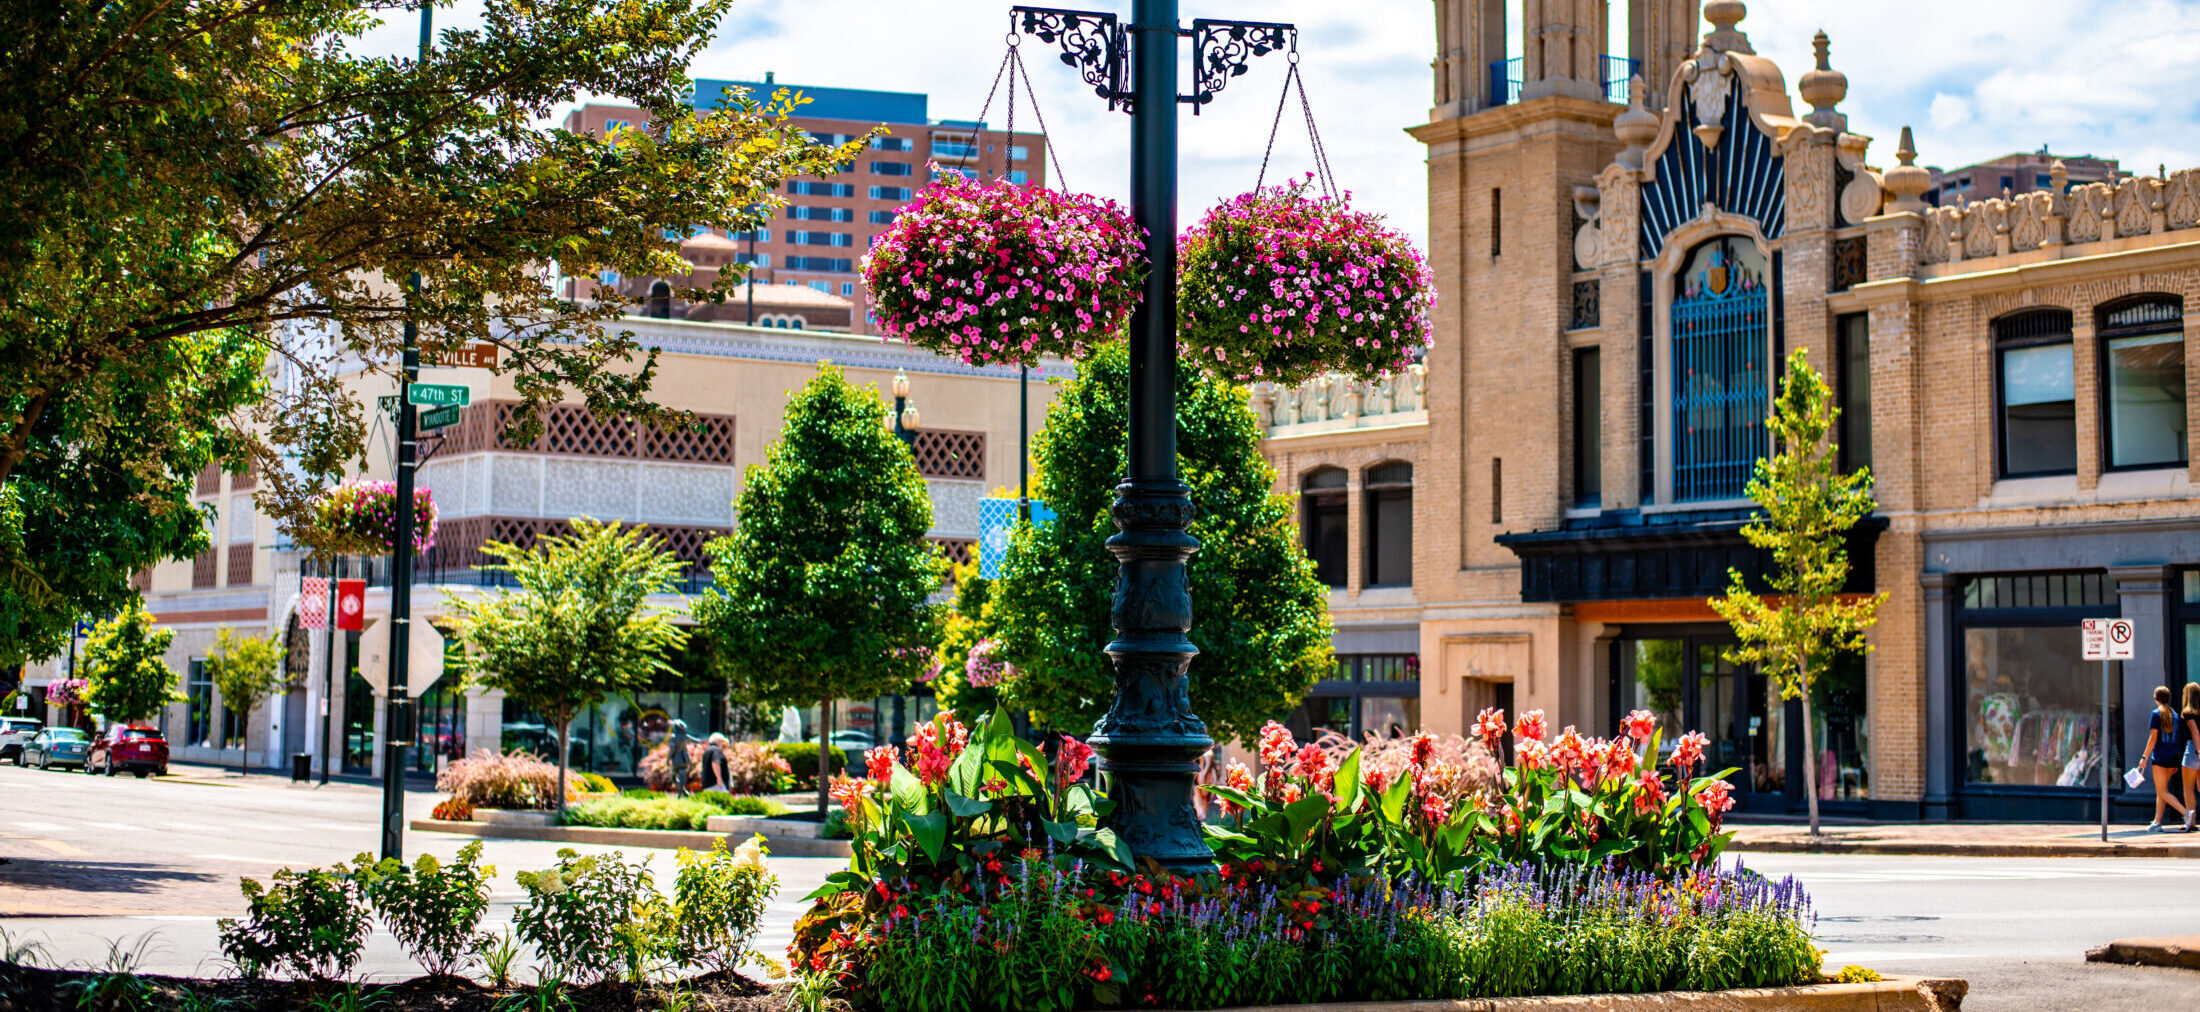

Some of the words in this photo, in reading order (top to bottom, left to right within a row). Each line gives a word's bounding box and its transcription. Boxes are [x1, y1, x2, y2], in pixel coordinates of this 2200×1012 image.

[428, 350, 477, 366] EVILLE
[483, 356, 495, 365] AVE
[420, 387, 445, 401] 47th
[451, 389, 463, 403] ST
[2084, 621, 2094, 630] NO
